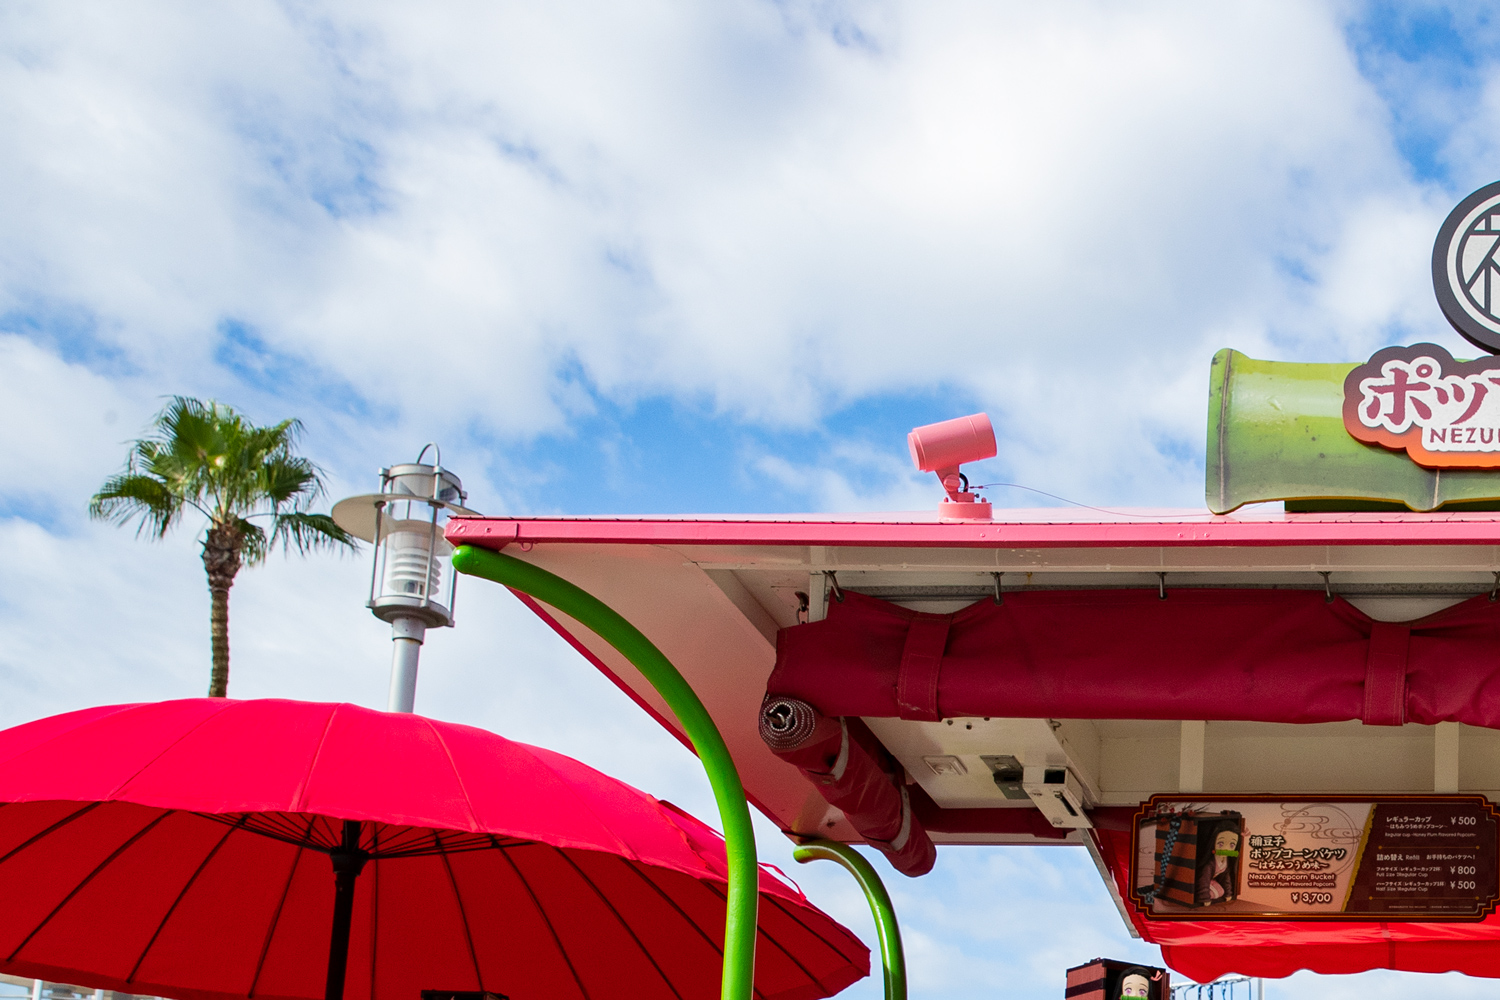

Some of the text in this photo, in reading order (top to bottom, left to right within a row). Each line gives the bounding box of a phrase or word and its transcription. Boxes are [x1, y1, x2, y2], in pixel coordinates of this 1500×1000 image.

[1251, 849, 1344, 859] ポップコーンバケツ
